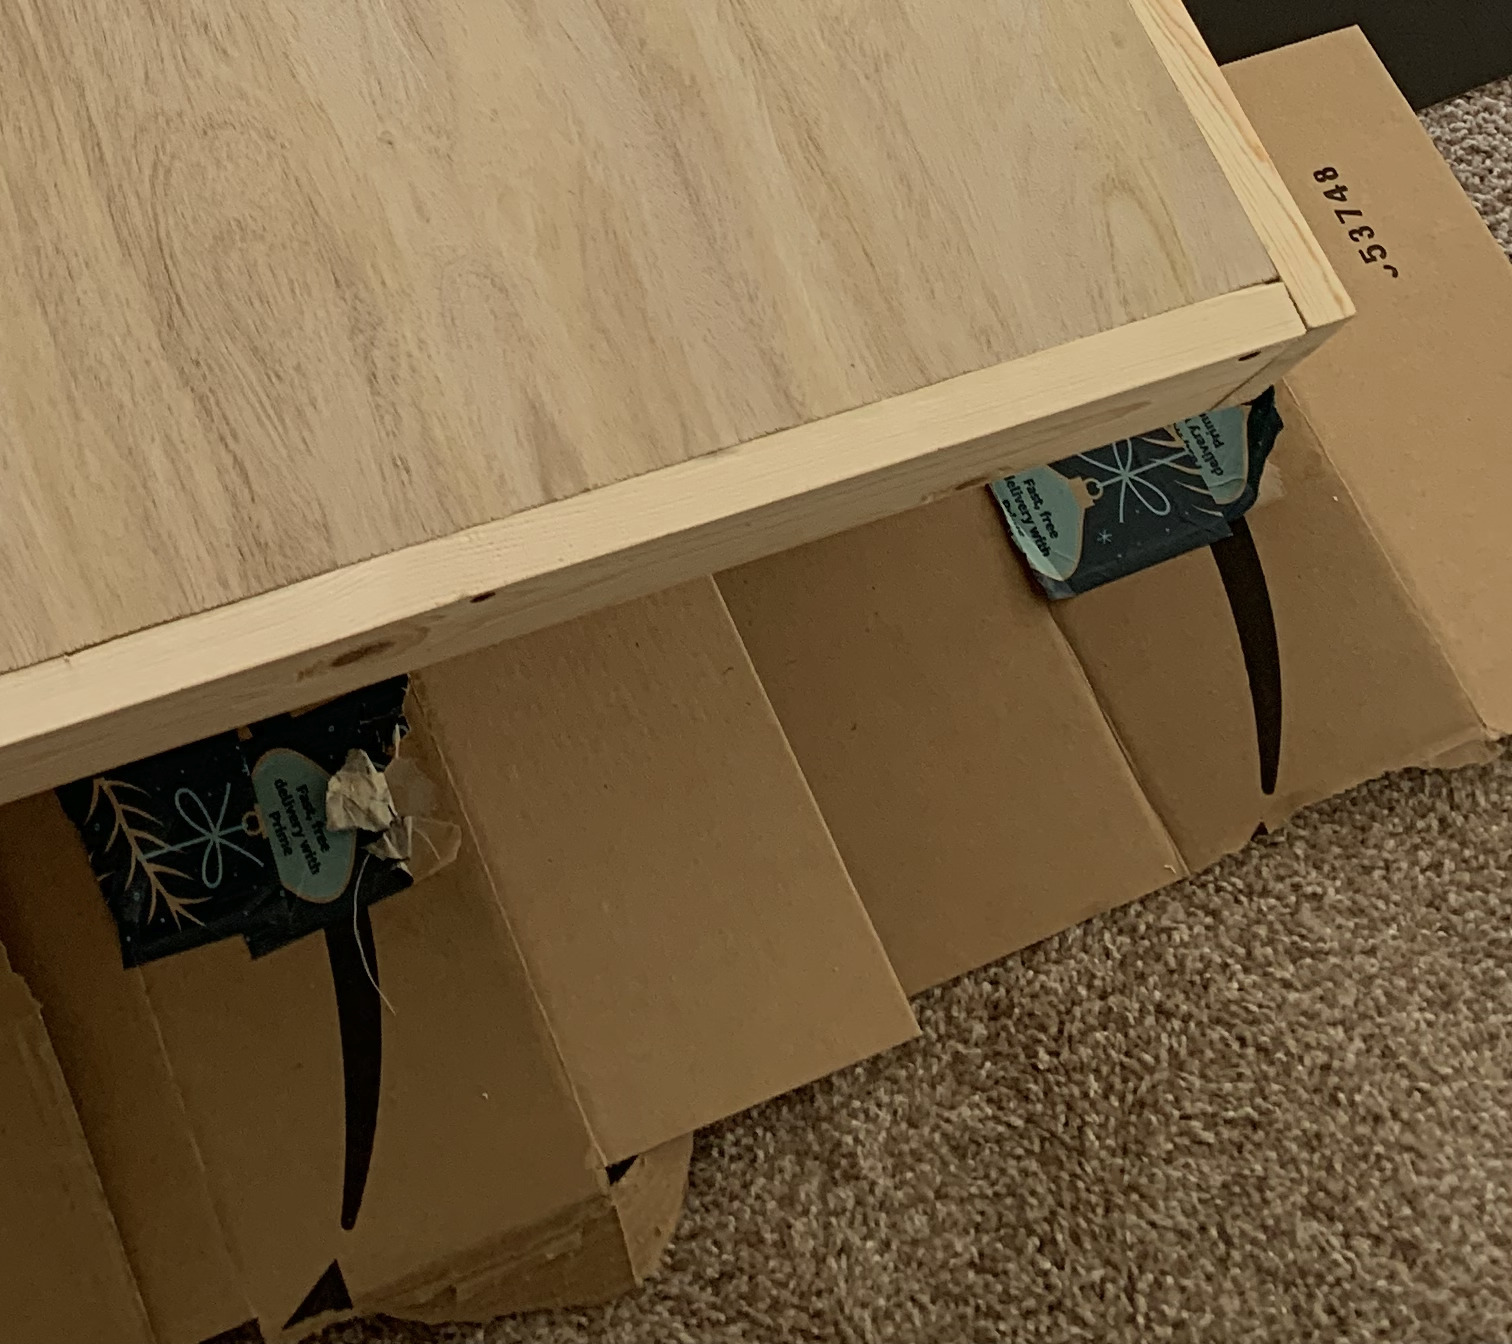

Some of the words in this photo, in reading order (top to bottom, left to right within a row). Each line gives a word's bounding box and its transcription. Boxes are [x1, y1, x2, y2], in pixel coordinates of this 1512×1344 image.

[1188, 424, 1225, 477] delivery
[1023, 477, 1043, 510] Fast,
[1039, 508, 1060, 540] free
[1029, 525, 1052, 558] with
[268, 811, 293, 857] Prime
[274, 778, 305, 837] delivery
[300, 839, 322, 875] with
[296, 783, 316, 821] Fast,
[311, 820, 331, 853] free
